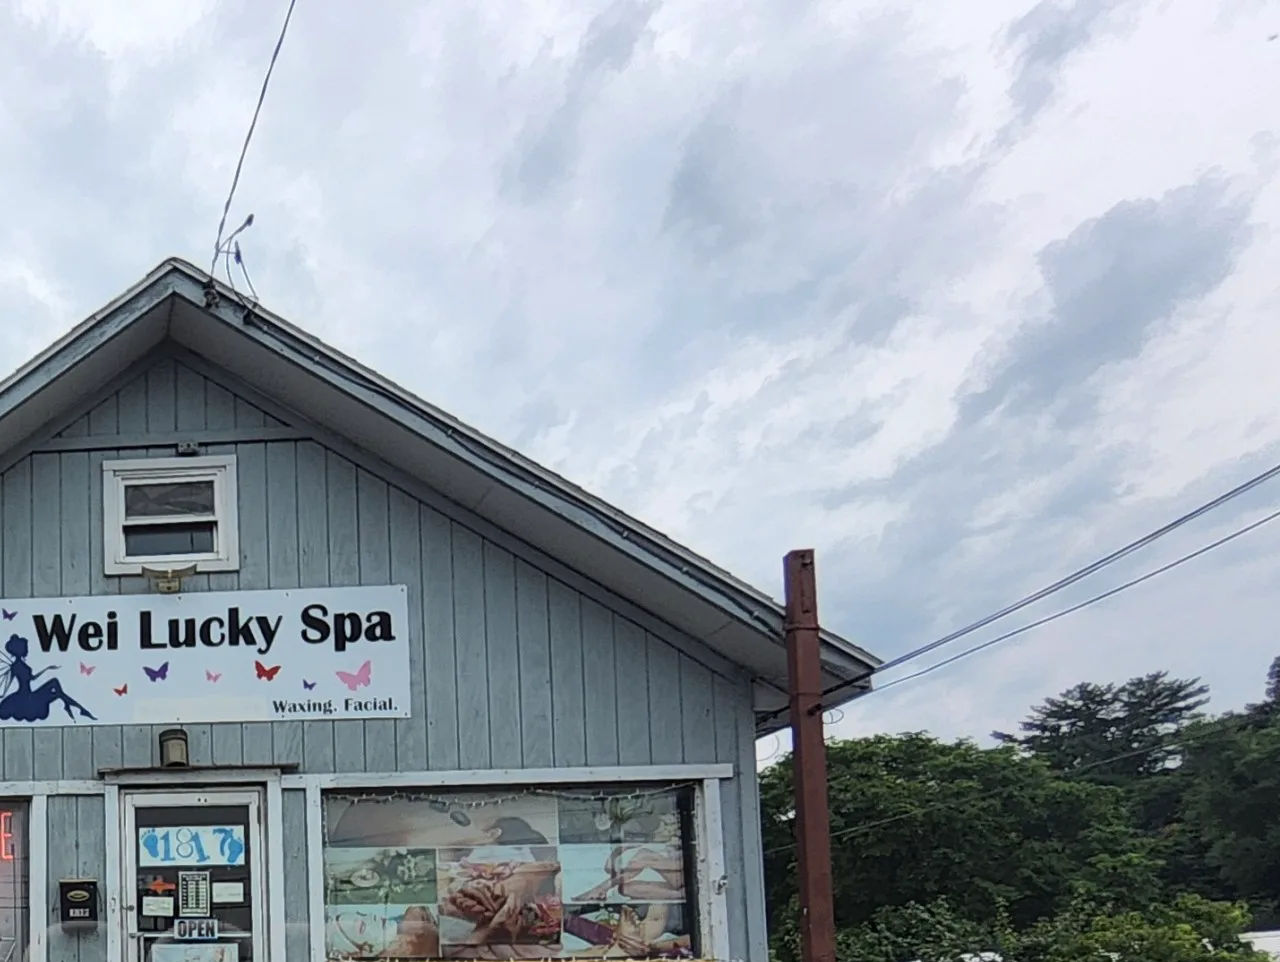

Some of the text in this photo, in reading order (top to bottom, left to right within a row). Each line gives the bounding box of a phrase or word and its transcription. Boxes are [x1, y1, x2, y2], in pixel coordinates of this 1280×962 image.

[32, 603, 396, 655] Wei Lucky Spa
[160, 827, 234, 864] 1817
[177, 920, 216, 938] OPEN
